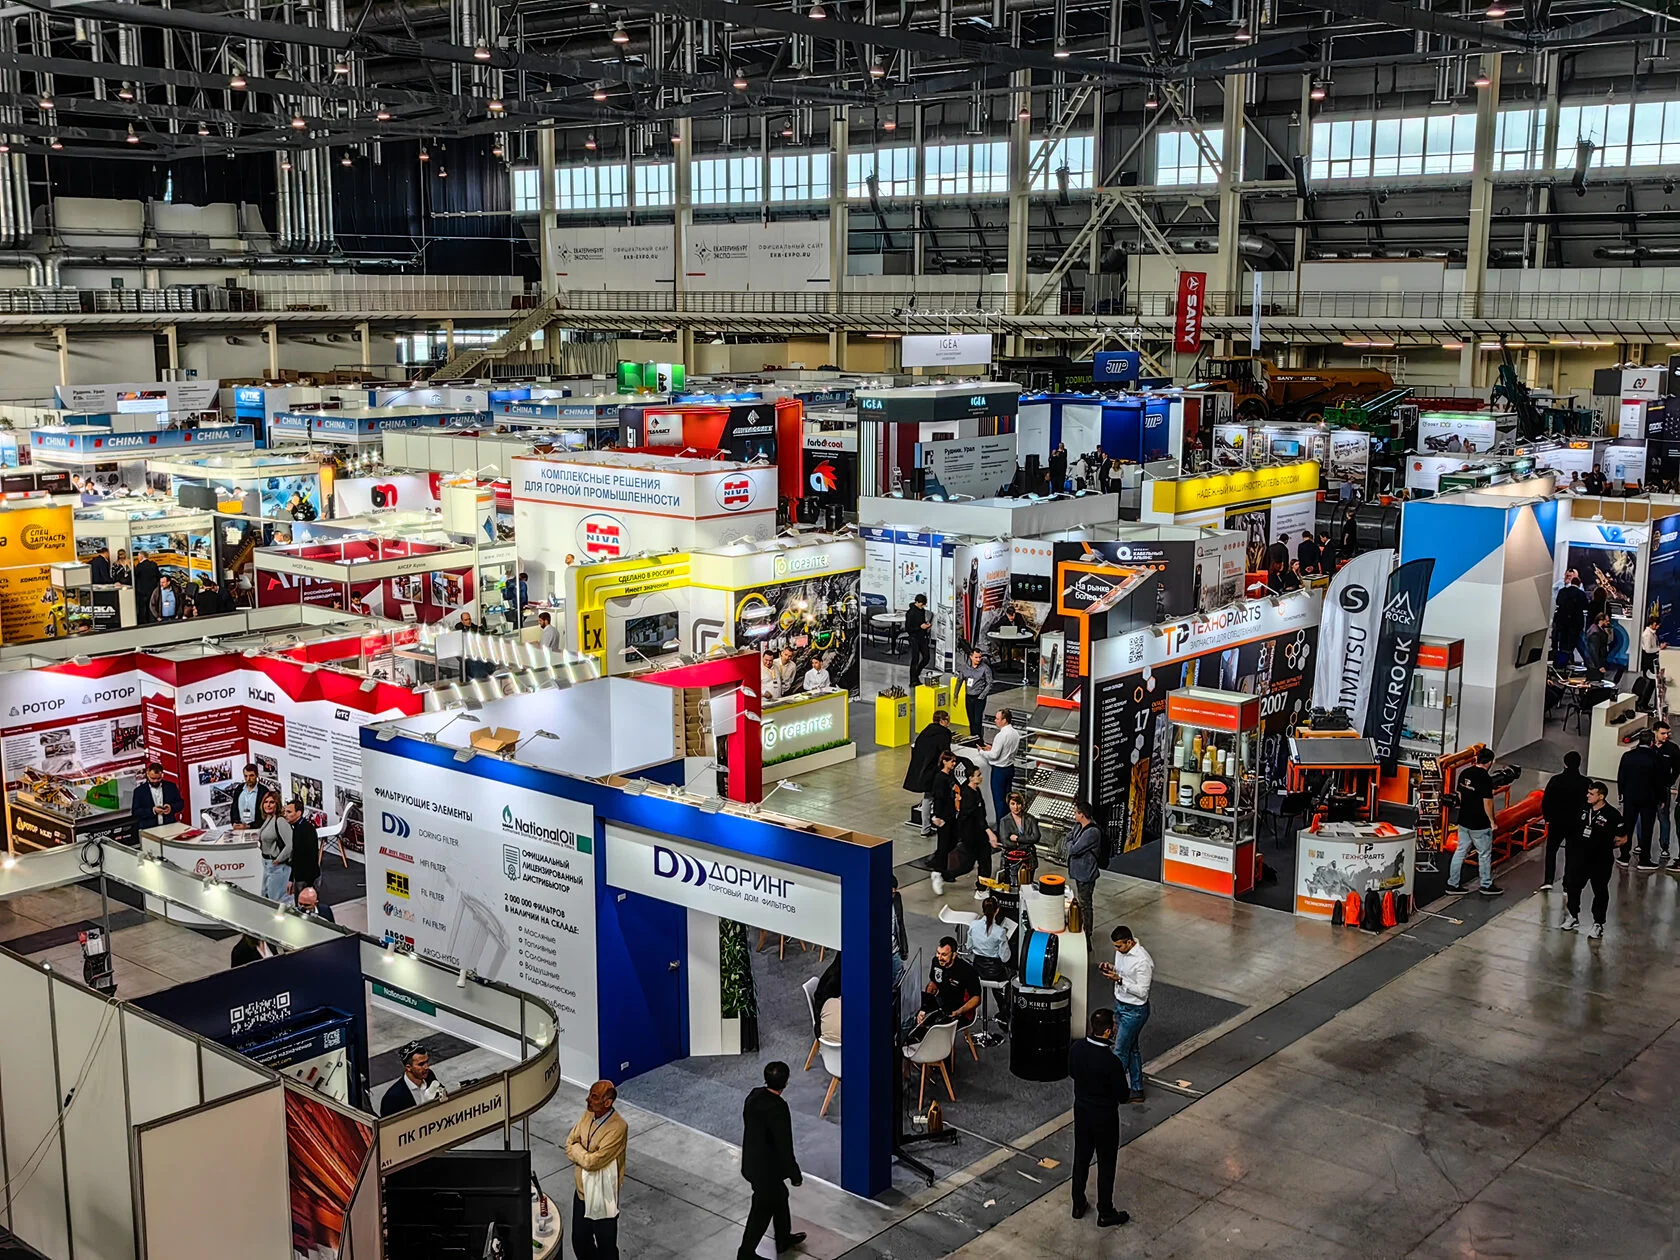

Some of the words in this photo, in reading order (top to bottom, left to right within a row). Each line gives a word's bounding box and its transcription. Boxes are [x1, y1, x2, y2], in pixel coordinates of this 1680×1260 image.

[713, 244, 748, 252] ЕКАТЕРИНБУРГ
[713, 252, 730, 260] ЭКСПО
[1184, 294, 1199, 346] SANY
[940, 338, 958, 349] IGEA
[1064, 374, 1093, 385] ZOOMLIO
[862, 400, 882, 410] IGEA
[970, 396, 986, 407] IGEA
[512, 406, 534, 414] CHINA
[564, 408, 590, 416] CHINA
[282, 416, 302, 426] CHINA
[324, 420, 346, 430] CHINA
[379, 419, 407, 431] CHINA
[450, 416, 475, 427] CHINA
[45, 436, 66, 448] CHINA
[108, 436, 144, 448] CHINA
[196, 430, 230, 442] CHINA
[540, 468, 610, 485] КОМПЛЕКСНЫЕ
[612, 475, 661, 490] РЕШЕНИЯ
[524, 480, 543, 492] ДЛЯ
[544, 482, 581, 496] ГОРНОЙ
[583, 486, 680, 507] ПРОМЫШЛЕННОСТИ
[724, 488, 749, 497] NIVA
[1196, 484, 1230, 500] НАДЕЖНЫЙ
[1230, 477, 1280, 494] МАШИНОСТРОИТЕЛЬ
[1280, 475, 1300, 487] РОССИИ
[30, 528, 49, 538] СПЕЦ
[30, 533, 66, 544] ЗАПЧАСТЬ
[586, 534, 620, 544] NIVA
[43, 542, 66, 550] Калуга
[618, 572, 646, 584] СДЕЛАНО
[652, 568, 675, 578] РОССИИ
[624, 586, 643, 594] Имеет
[644, 582, 670, 592] значение
[1076, 582, 1086, 590] На
[1087, 584, 1110, 595] рынке
[1385, 611, 1411, 626] ROCK
[582, 614, 602, 651] Ex
[1190, 634, 1214, 650] ЗАПЧАСТИ
[1215, 632, 1228, 646] ДЛЯ
[1228, 624, 1262, 642] СПЕЦТЕХНИКИ
[94, 686, 135, 702] РОТОР
[196, 687, 236, 702] РОТОР
[1378, 636, 1412, 758] BLACKROCK
[22, 698, 66, 715] РОТОР
[1260, 691, 1288, 717] 2007
[780, 712, 833, 741] ГОРЭЛТЕХ
[1134, 708, 1150, 732] 17
[374, 788, 430, 812] ФИЛЬТРУЮЩИЕ
[432, 803, 473, 822] ЭЛЕМЕНТЫ
[418, 828, 442, 842] DORING
[442, 836, 460, 847] FILTER
[514, 817, 575, 846] NationalOil
[214, 862, 245, 872] РОТОР
[420, 858, 430, 868] HIFI
[430, 862, 447, 872] FILTER
[522, 849, 570, 870] ОФИЦИАЛЬНЫЙ
[522, 861, 584, 886] ЛИЦЕНЗИРОВАННЫЙ
[708, 862, 795, 899] ДОРИНГ
[386, 884, 409, 895] FILTER
[522, 874, 571, 893] ДИСТРИБЬЮТОР
[429, 890, 445, 902] FILTER
[708, 884, 742, 898] ТОРГОВЫЙ
[744, 893, 759, 904] ДОМ
[762, 898, 796, 914] ФИЛЬТРОВ
[504, 892, 508, 901] 2
[509, 896, 520, 904] 000
[521, 898, 532, 908] 000
[533, 902, 566, 918] ФИЛЬТРОВ
[422, 918, 432, 928] FAI
[504, 904, 509, 912] В
[510, 906, 540, 922] НАЛИЧИИ
[540, 915, 550, 926] НА
[551, 918, 580, 935] СКЛАДЕ:
[384, 928, 404, 941] ARGO
[524, 927, 556, 944] Масляные
[524, 938, 557, 956] Топливные
[423, 948, 460, 966] ARGO-HYTOS
[524, 950, 558, 968] Салонные
[524, 961, 560, 980] Воздушные
[524, 972, 576, 998] Гидравлические
[398, 1130, 416, 1148] ПК
[418, 1094, 502, 1140] ПРУЖИННЫЙ
[381, 1158, 392, 1168] A11
